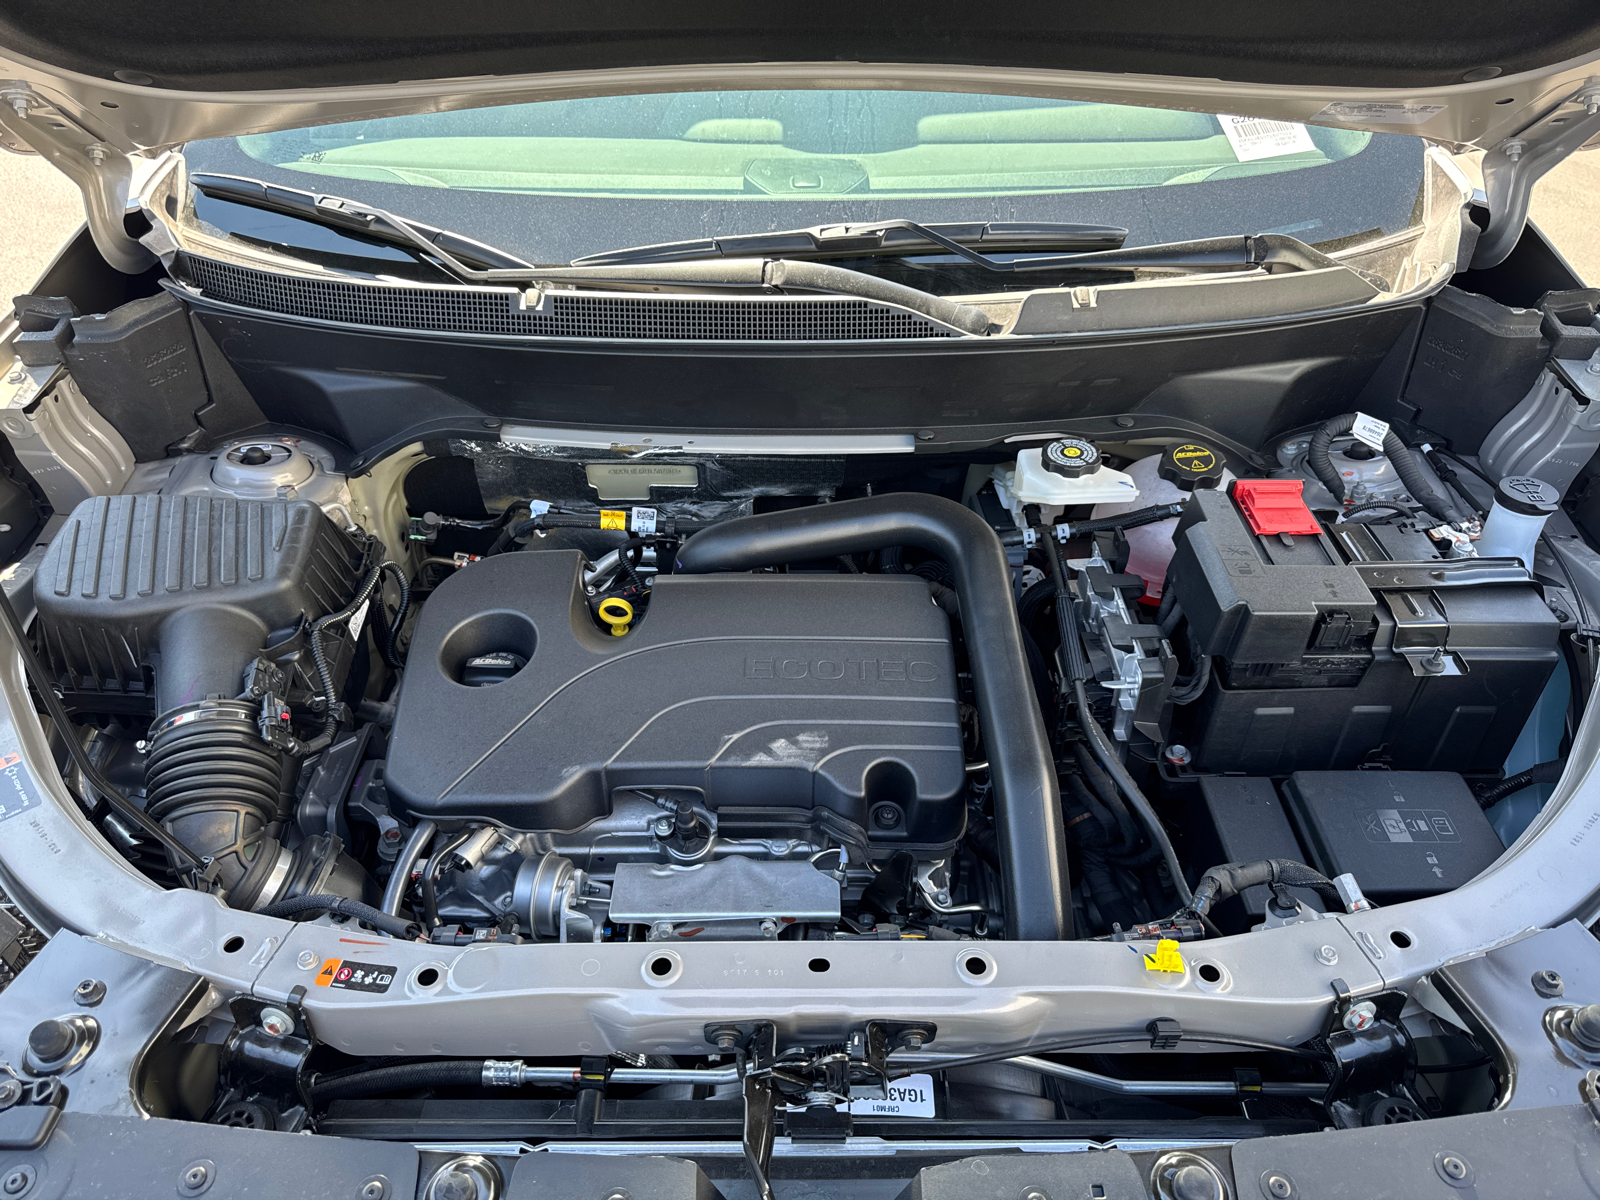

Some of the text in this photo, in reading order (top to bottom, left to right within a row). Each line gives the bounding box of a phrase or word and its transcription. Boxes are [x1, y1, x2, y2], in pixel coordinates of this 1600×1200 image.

[471, 658, 511, 666] ACDelco
[743, 656, 940, 682] ECOTEC
[872, 1104, 900, 1113] CRFM01
